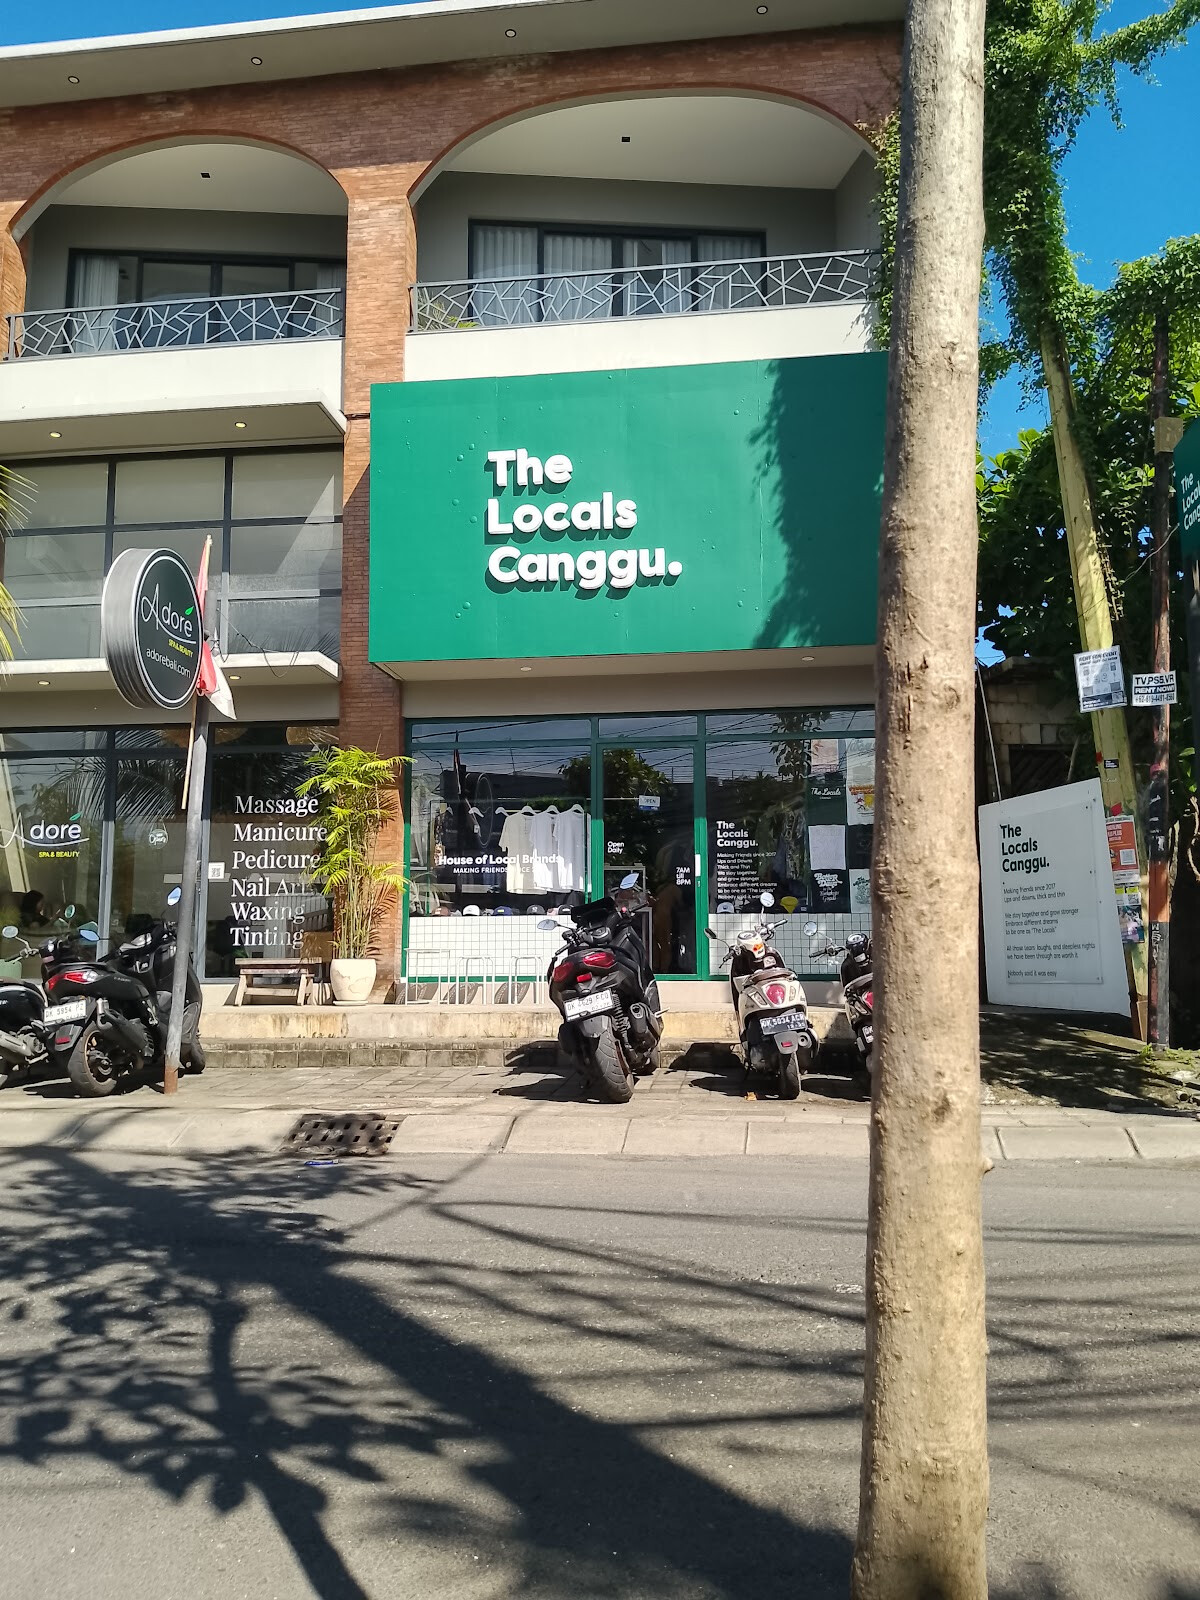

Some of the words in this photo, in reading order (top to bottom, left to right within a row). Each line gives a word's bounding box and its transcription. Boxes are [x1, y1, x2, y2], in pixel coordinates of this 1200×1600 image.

[487, 447, 573, 487] The
[1181, 473, 1193, 494] The
[487, 491, 638, 535] Locals
[488, 545, 683, 590] Canggu.
[146, 648, 190, 678] adorebali.com
[822, 788, 841, 796] Locals
[234, 796, 319, 817] Massage
[233, 822, 328, 842] Manicure
[716, 820, 735, 829] The
[716, 829, 748, 838] Locals
[1000, 824, 1021, 838] The
[607, 840, 625, 848] Open
[716, 838, 758, 849] Canggu.
[1002, 837, 1038, 856] Locals
[232, 849, 321, 869] Pedicure
[438, 854, 474, 866] House
[474, 854, 488, 865] of
[489, 854, 520, 865] Local
[1002, 856, 1050, 874] Canggu.
[230, 877, 270, 897] Nail
[230, 902, 305, 924] Waxing
[230, 926, 304, 950] Tinting
[1008, 970, 1023, 978] Nobody
